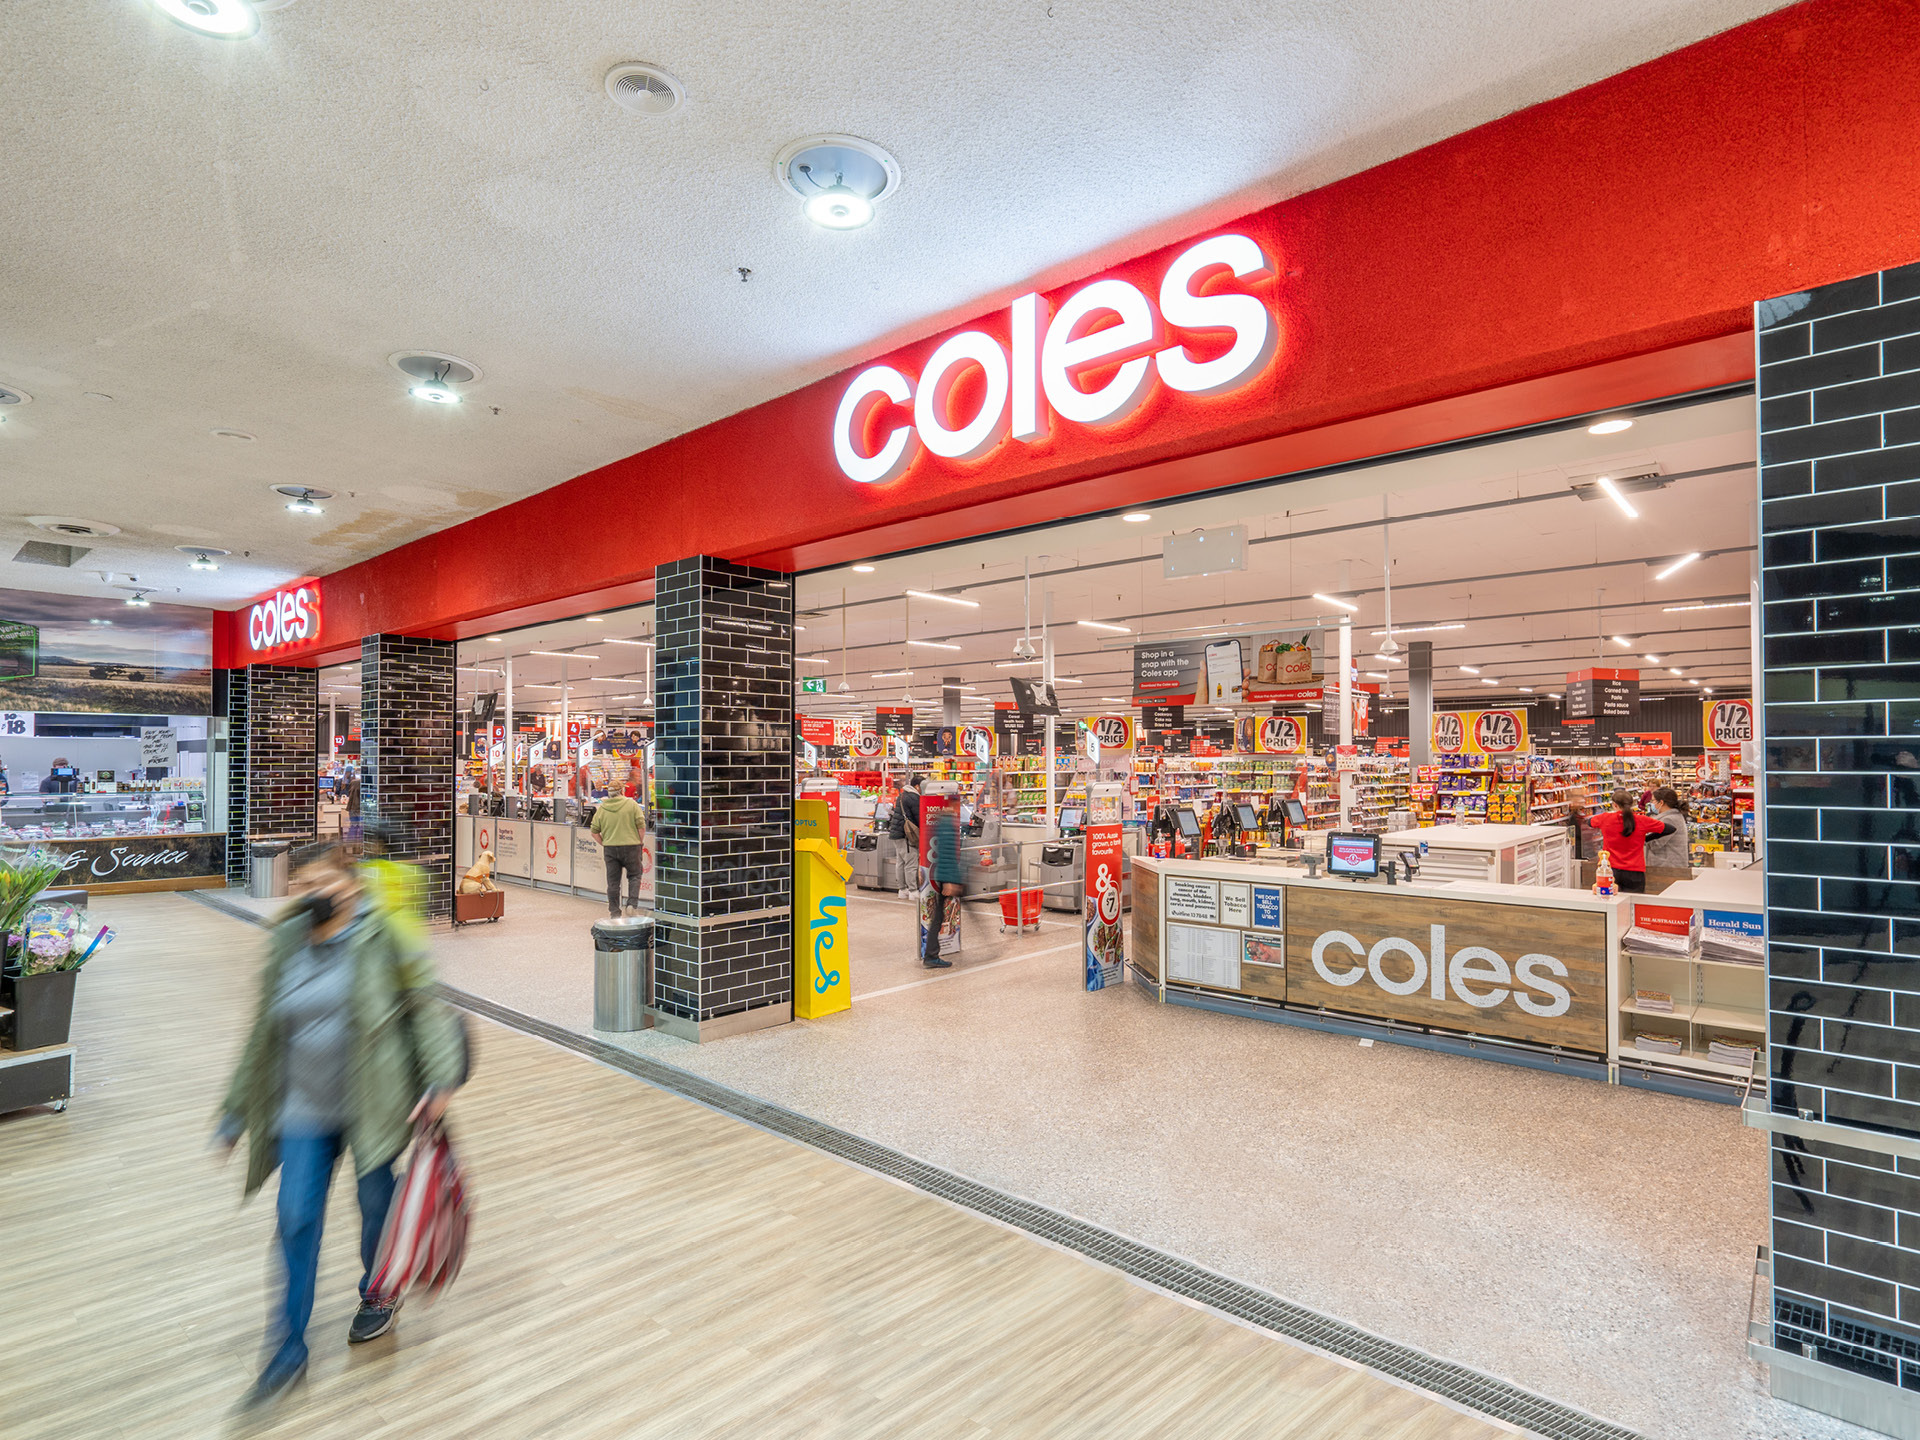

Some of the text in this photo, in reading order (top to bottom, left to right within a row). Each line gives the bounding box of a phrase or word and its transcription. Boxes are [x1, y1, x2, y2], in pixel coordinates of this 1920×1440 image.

[834, 234, 1270, 483] coles
[249, 588, 310, 650] coles
[1285, 662, 1311, 673] coles
[1615, 670, 1618, 679] 2
[1717, 704, 1748, 726] 1/2
[570, 724, 577, 733] 4
[1099, 719, 1122, 734] 1/2
[1268, 720, 1294, 737] 1/2
[1441, 715, 1458, 735] 1/2
[1482, 714, 1513, 735] 1/2
[1100, 735, 1124, 743] PRICE
[1716, 728, 1750, 740] PRICE
[1266, 738, 1296, 747] PRICE
[1439, 736, 1460, 746] PRICE
[1482, 735, 1516, 746] PRICE
[1091, 743, 1095, 752] 5
[91, 846, 190, 876] Service
[547, 866, 557, 874] ZERO
[1096, 864, 1112, 892] &
[1708, 919, 1761, 930] Herald Sun
[1311, 924, 1570, 1017] coles
